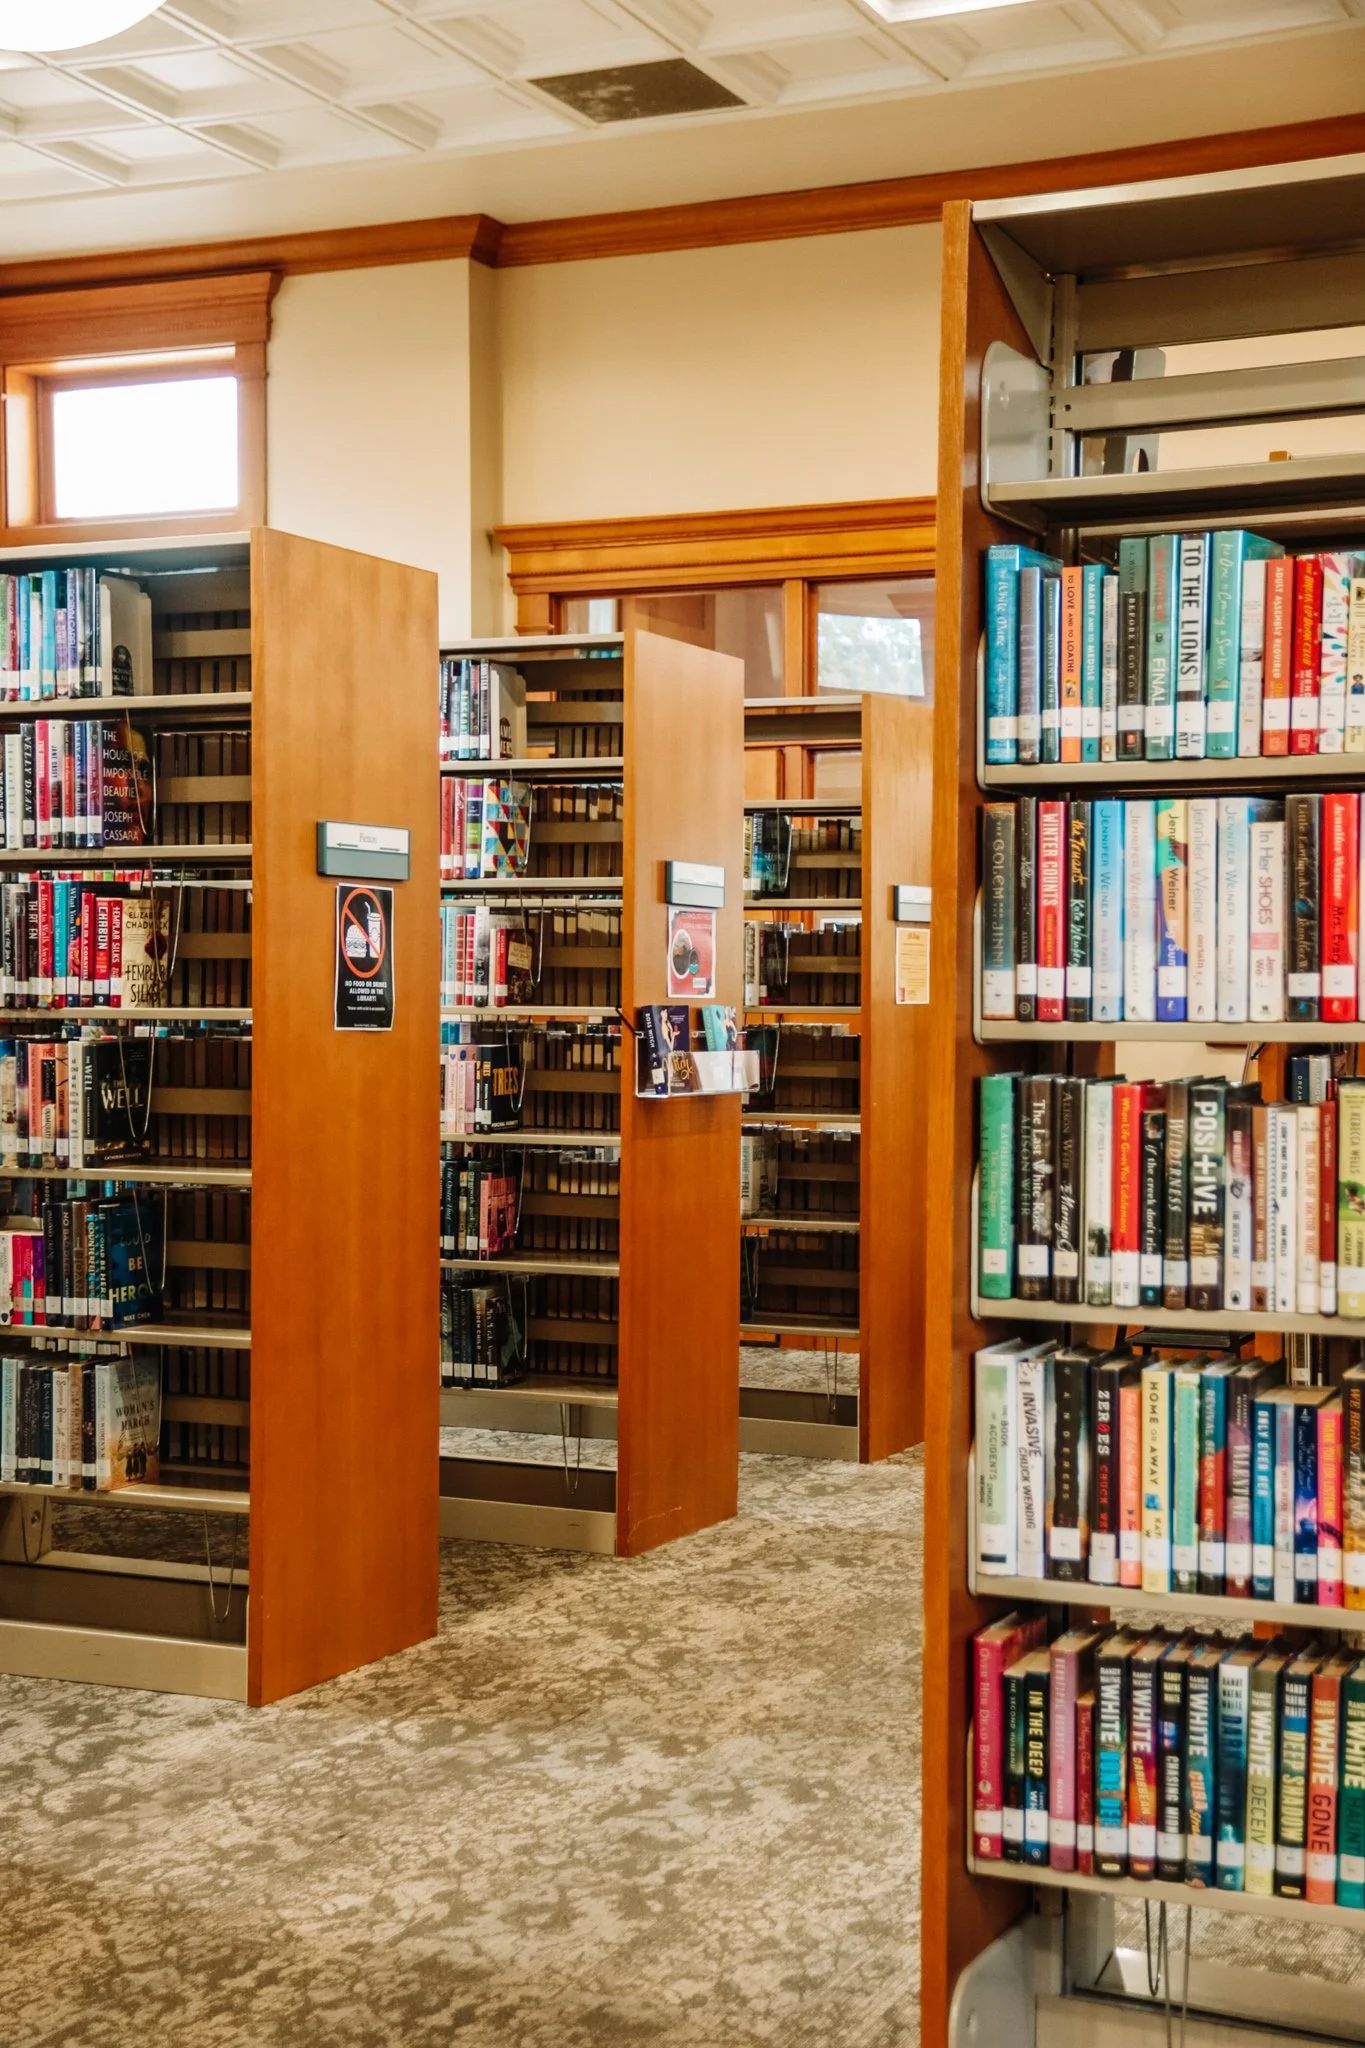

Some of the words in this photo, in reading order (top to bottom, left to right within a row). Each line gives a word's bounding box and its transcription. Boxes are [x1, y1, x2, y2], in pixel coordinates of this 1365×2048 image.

[1183, 546, 1200, 567] TO
[1066, 586, 1075, 609] LOVE
[1182, 575, 1199, 609] THE
[1273, 567, 1284, 592] ADULT
[1087, 583, 1095, 616] MARRY
[1128, 598, 1136, 639] BEFORE
[1272, 596, 1283, 636] ASSEMBLY
[1066, 640, 1075, 673] LOATHE
[1087, 645, 1095, 680] MEDDLE
[1180, 621, 1198, 675] LIONS
[1272, 639, 1282, 678] REQUIRED
[1303, 644, 1314, 665] CLUB
[24, 736, 32, 773] NELLY
[103, 749, 129, 760] HOUSE
[24, 779, 32, 812] DEAN
[104, 812, 133, 822] JOSEPH
[1042, 813, 1058, 857] WINTER
[1192, 805, 1210, 860] Jennifer
[1258, 830, 1274, 841] In
[1298, 804, 1307, 831] Little
[1334, 803, 1345, 853] Jennifer
[1100, 808, 1109, 867] JENNIFER
[993, 840, 1004, 899] GOLEM
[1070, 838, 1086, 885] Truants
[1258, 846, 1274, 872] Her
[1334, 856, 1345, 899] Weiner
[68, 888, 76, 908] What
[1042, 861, 1058, 906] COUNTS
[1100, 872, 1109, 917] WEINER
[1167, 868, 1179, 910] Weiner
[1193, 868, 1210, 924] Weiner
[1258, 877, 1274, 924] SHOES
[97, 907, 107, 949] CHABON
[112, 943, 120, 962] SILKS
[84, 1065, 92, 1092] WELL
[101, 1087, 143, 1110] WELL
[1033, 1100, 1045, 1124] The
[1120, 1097, 1130, 1122] When
[1033, 1129, 1045, 1152] Last
[1120, 1123, 1130, 1140] Life
[1033, 1156, 1045, 1198] White
[1147, 1158, 1156, 1174] the
[1169, 1118, 1184, 1211] WILDERNESS
[1147, 1178, 1156, 1206] creek
[1033, 1202, 1045, 1231] Rose
[1147, 1210, 1156, 1234] don't
[128, 1257, 142, 1271] BE
[1148, 1382, 1158, 1423] HOME
[1350, 1388, 1361, 1408] WE
[1022, 1392, 1041, 1457] INVASIVE
[1258, 1411, 1268, 1436] ONLY
[1350, 1412, 1361, 1451] BEGIN
[988, 1424, 997, 1479] ACCIDENTS
[1018, 1447, 1030, 1482] CHUCK
[1148, 1446, 1158, 1485] AWAY
[1258, 1442, 1268, 1470] EVER
[1350, 1453, 1361, 1468] AT
[1258, 1475, 1268, 1497] HER
[1022, 1486, 1034, 1529] WENDIG
[1030, 1691, 1042, 1705] IN
[1100, 1686, 1120, 1744] WHITE
[1030, 1712, 1042, 1736] THE
[1132, 1689, 1151, 1752] WHITE
[1190, 1693, 1208, 1756] WHITE
[1030, 1742, 1042, 1775] DEEP
[1251, 1710, 1270, 1775] WHITE
[1283, 1731, 1303, 1770] DEEP
[1313, 1719, 1335, 1784] WHITE
[1344, 1721, 1365, 1788] WHITE
[1132, 1757, 1151, 1814] CARIBBEAN
[1165, 1756, 1180, 1801] CHASING
[1190, 1771, 1207, 1810] CUBA
[1283, 1774, 1303, 1841] SHADOW
[1312, 1794, 1330, 1853] GONE
